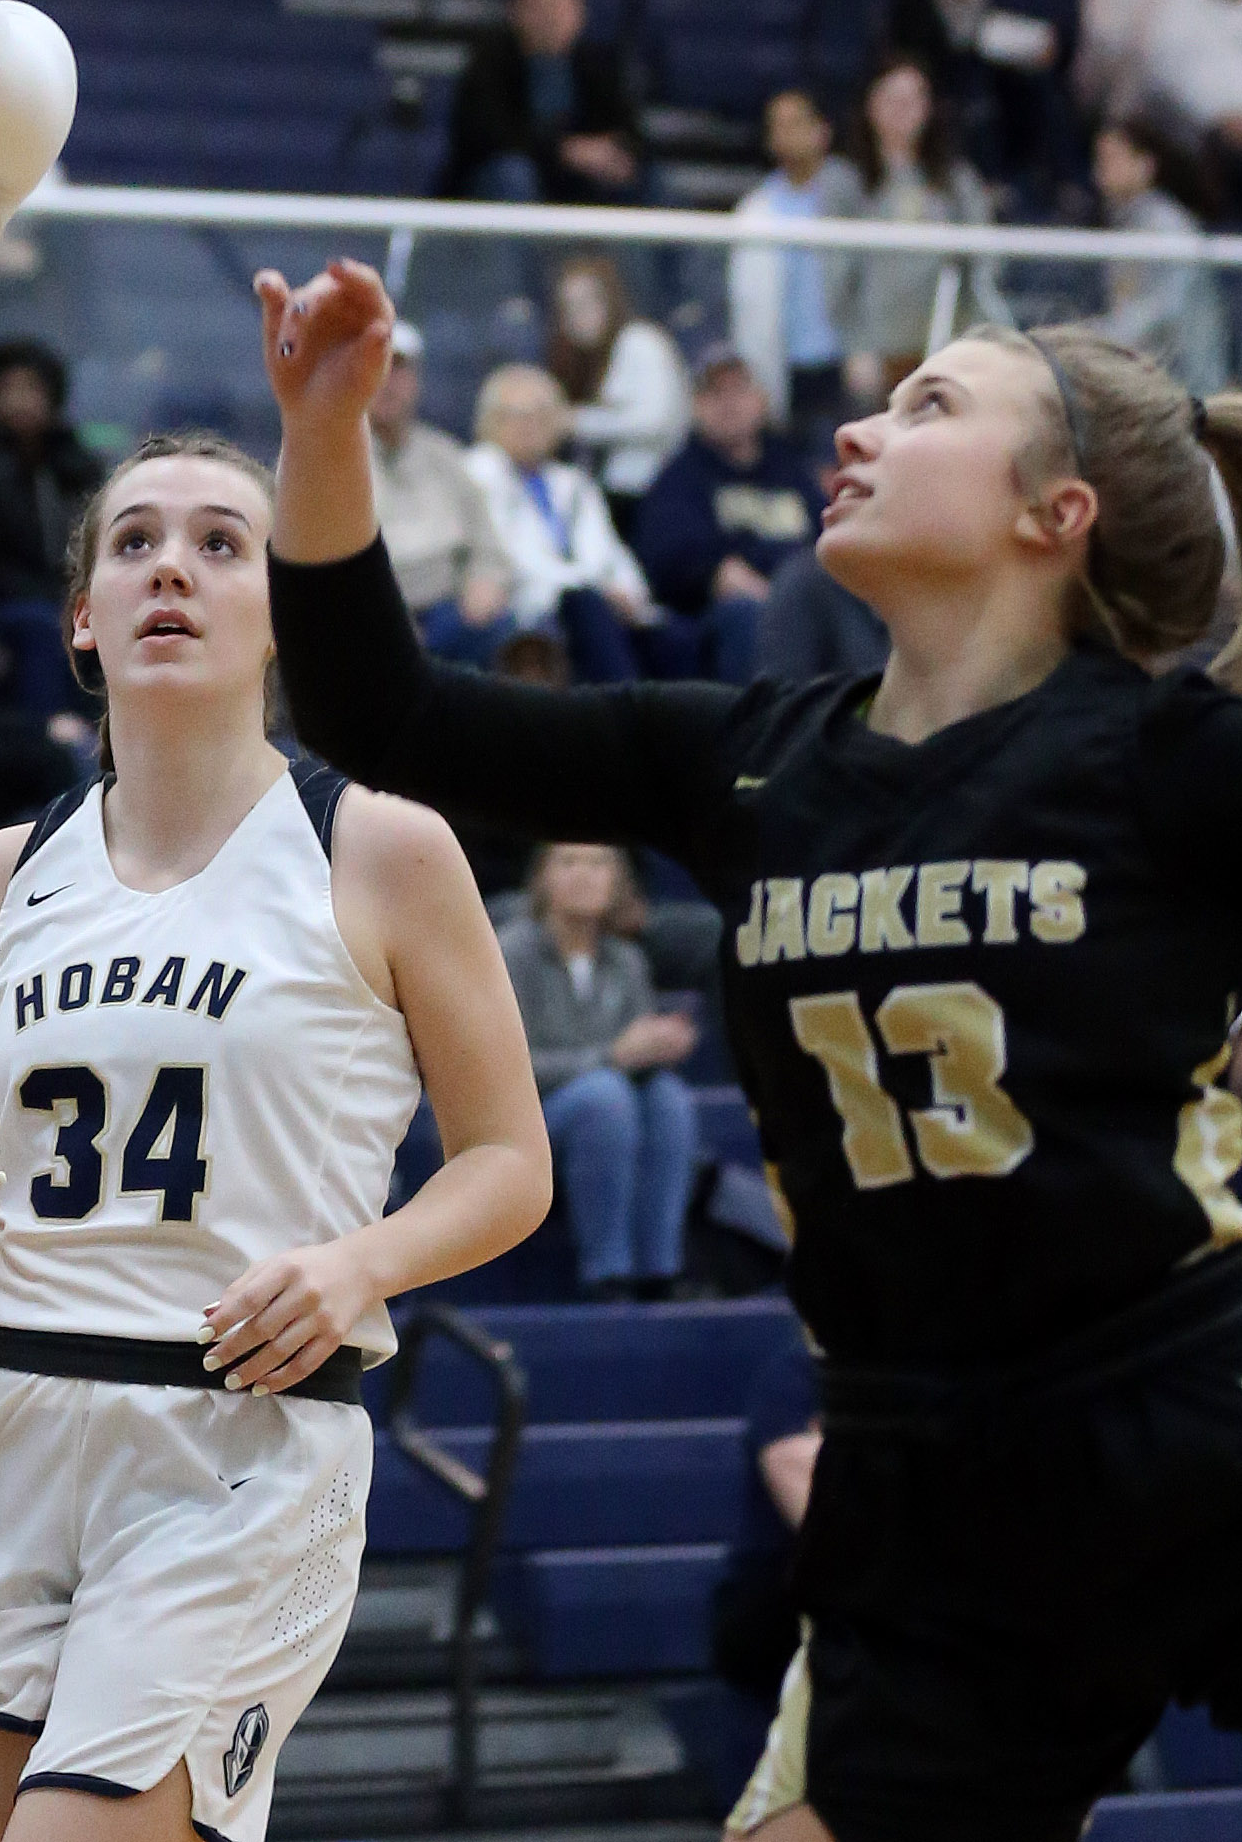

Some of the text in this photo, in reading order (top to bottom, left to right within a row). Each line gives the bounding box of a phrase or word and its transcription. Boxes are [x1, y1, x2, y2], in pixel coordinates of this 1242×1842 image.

[736, 859, 1088, 967] JACKETS
[14, 955, 248, 1034] HOBAN
[15, 1062, 213, 1227] 34
[788, 981, 1035, 1189] 13
